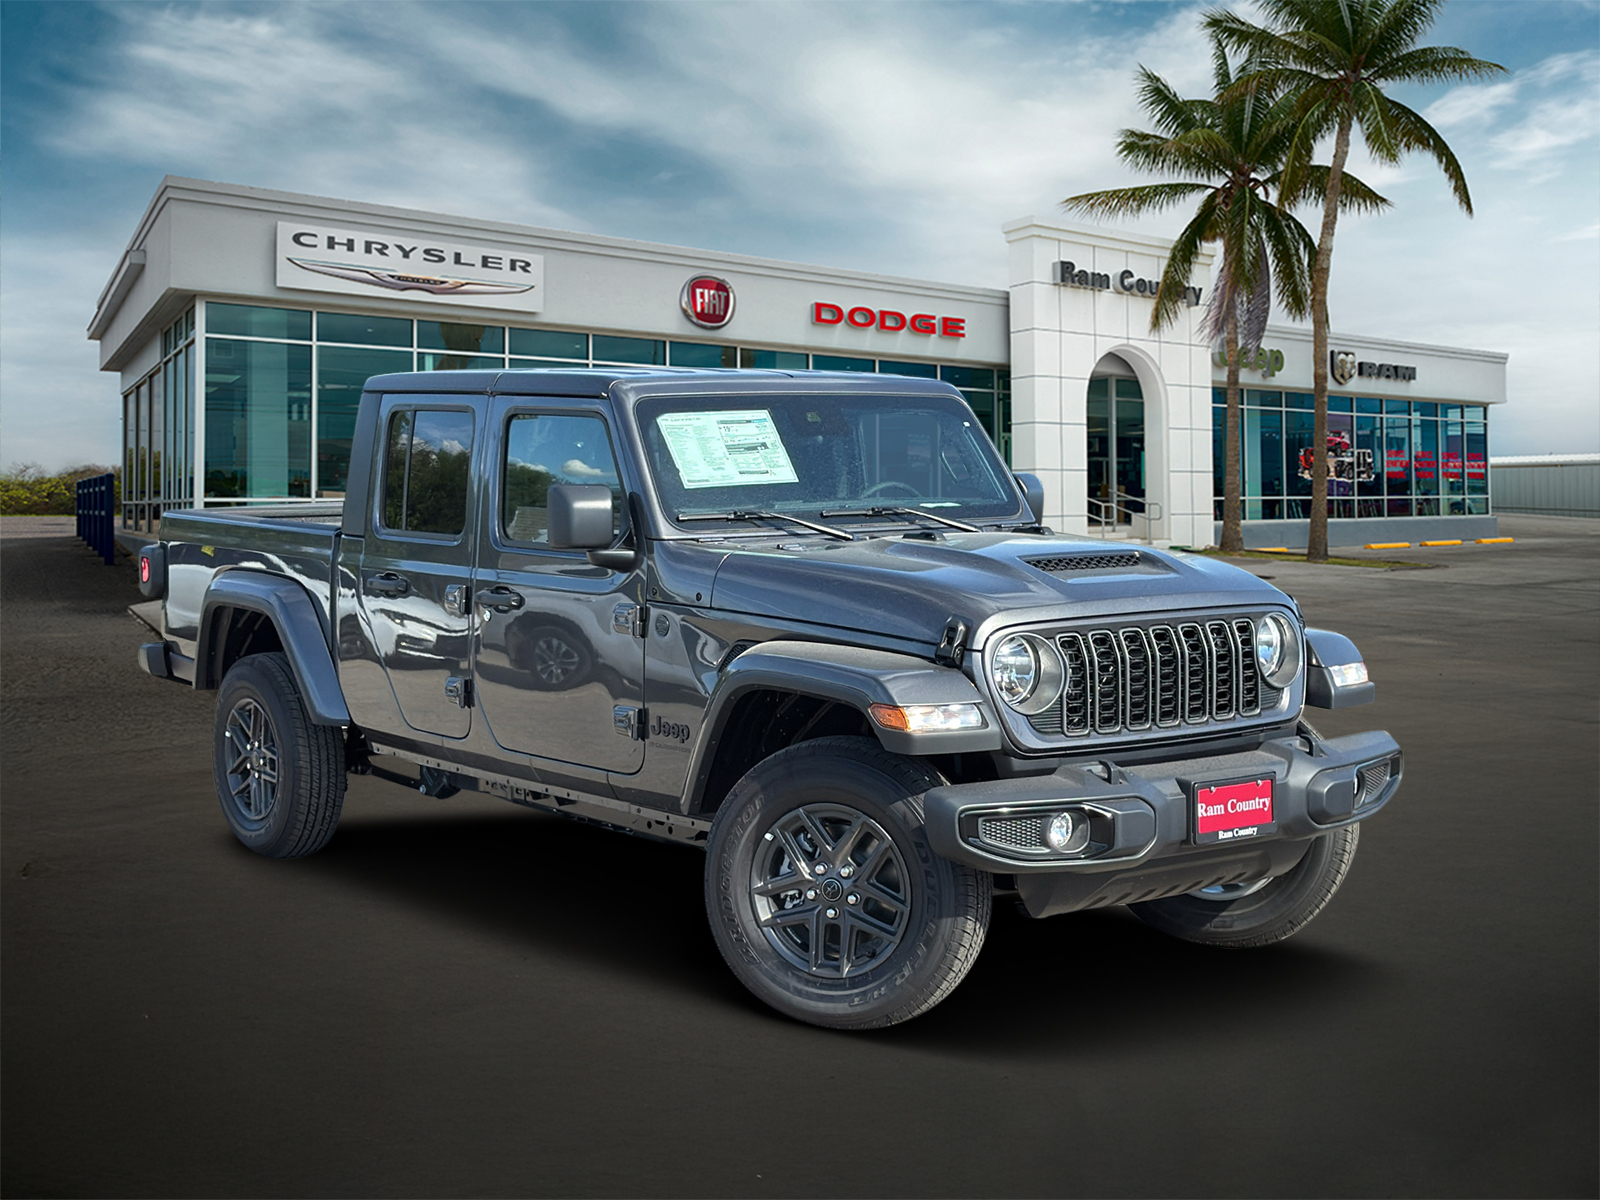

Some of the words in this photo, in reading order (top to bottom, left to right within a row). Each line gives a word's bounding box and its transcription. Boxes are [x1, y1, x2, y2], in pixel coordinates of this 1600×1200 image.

[292, 232, 533, 274] CHRYSLER
[1059, 260, 1111, 290] Ram
[695, 287, 728, 316] FIAT
[812, 301, 966, 338] DODGE
[1359, 361, 1417, 381] RAM
[650, 714, 691, 744] Jeep
[1197, 802, 1225, 818] Ram
[1227, 797, 1270, 813] Country
[1219, 831, 1232, 839] Ram
[1234, 827, 1257, 837] Country
